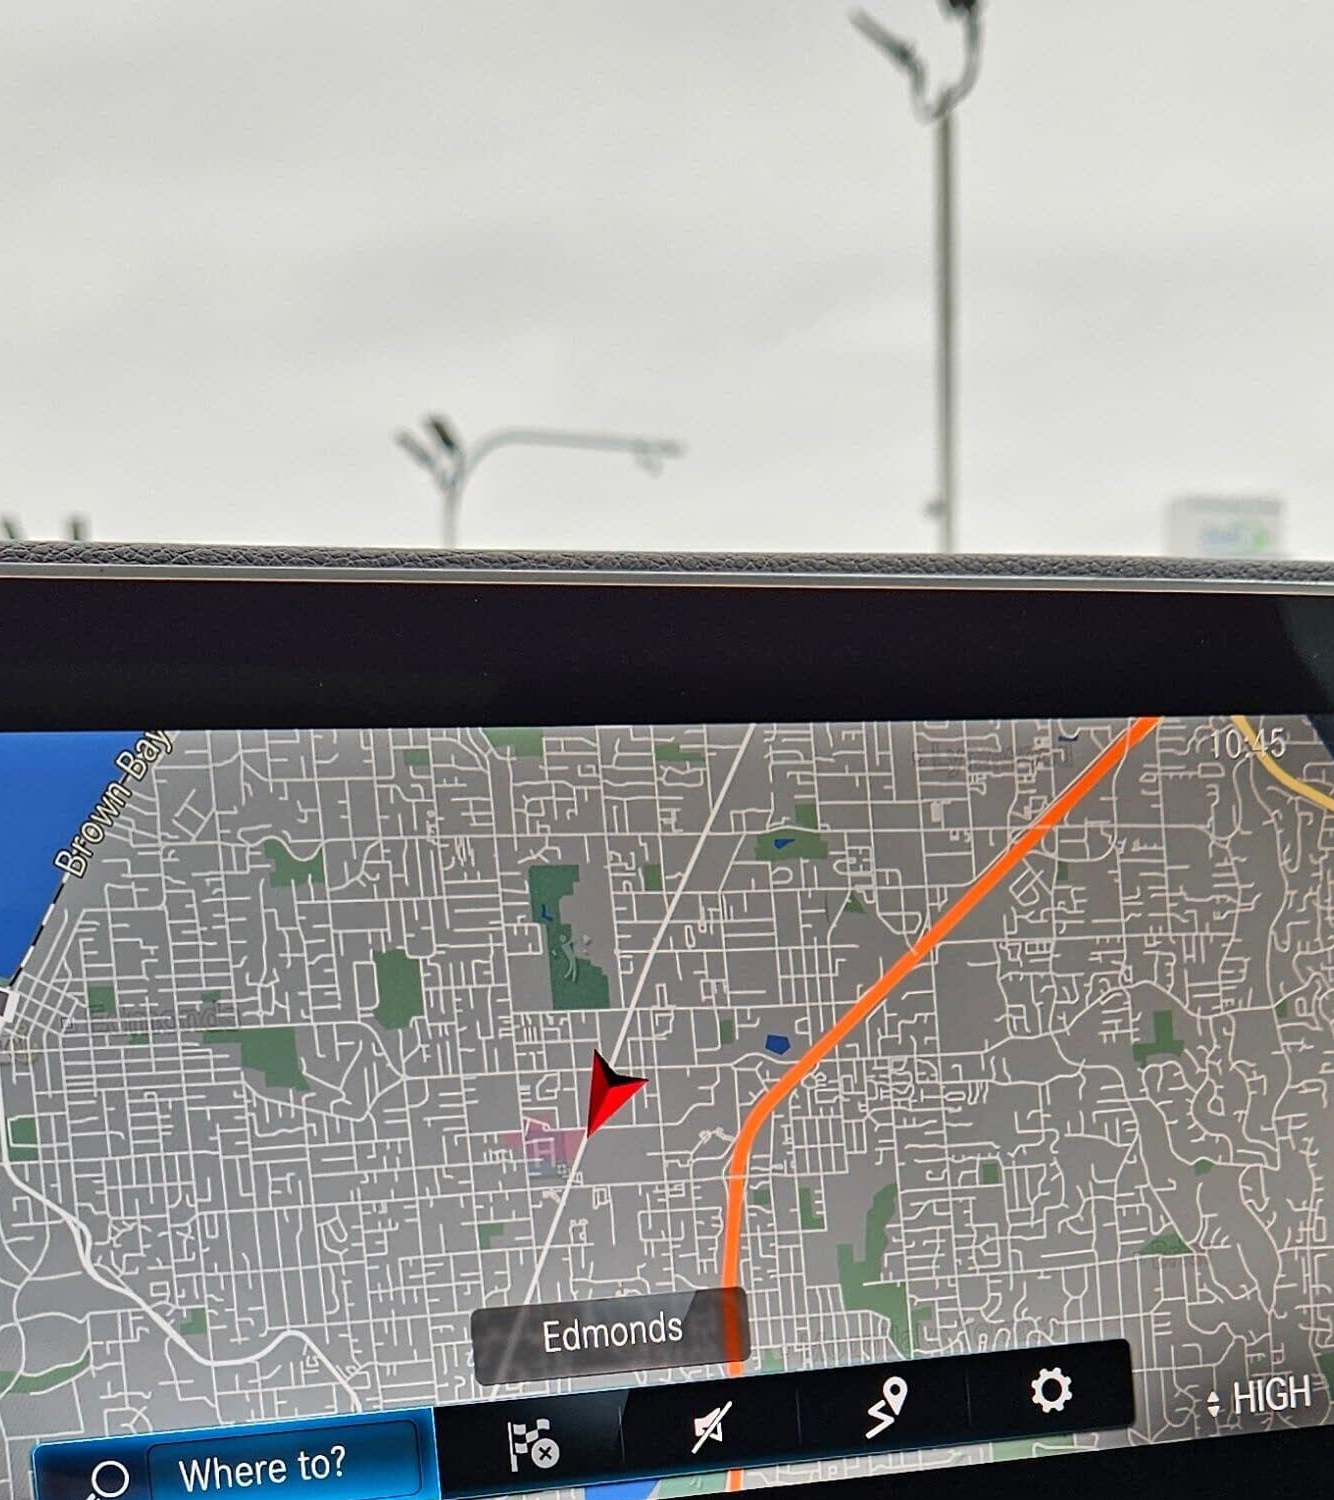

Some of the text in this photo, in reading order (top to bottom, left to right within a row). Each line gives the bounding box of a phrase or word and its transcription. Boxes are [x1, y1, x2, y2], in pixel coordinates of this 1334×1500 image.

[1210, 727, 1286, 759] 10:45
[53, 730, 173, 878] Brown Bay
[542, 1310, 683, 1353] Edmonds
[1234, 1374, 1312, 1414] HIGH
[178, 1445, 346, 1493] Where to?
